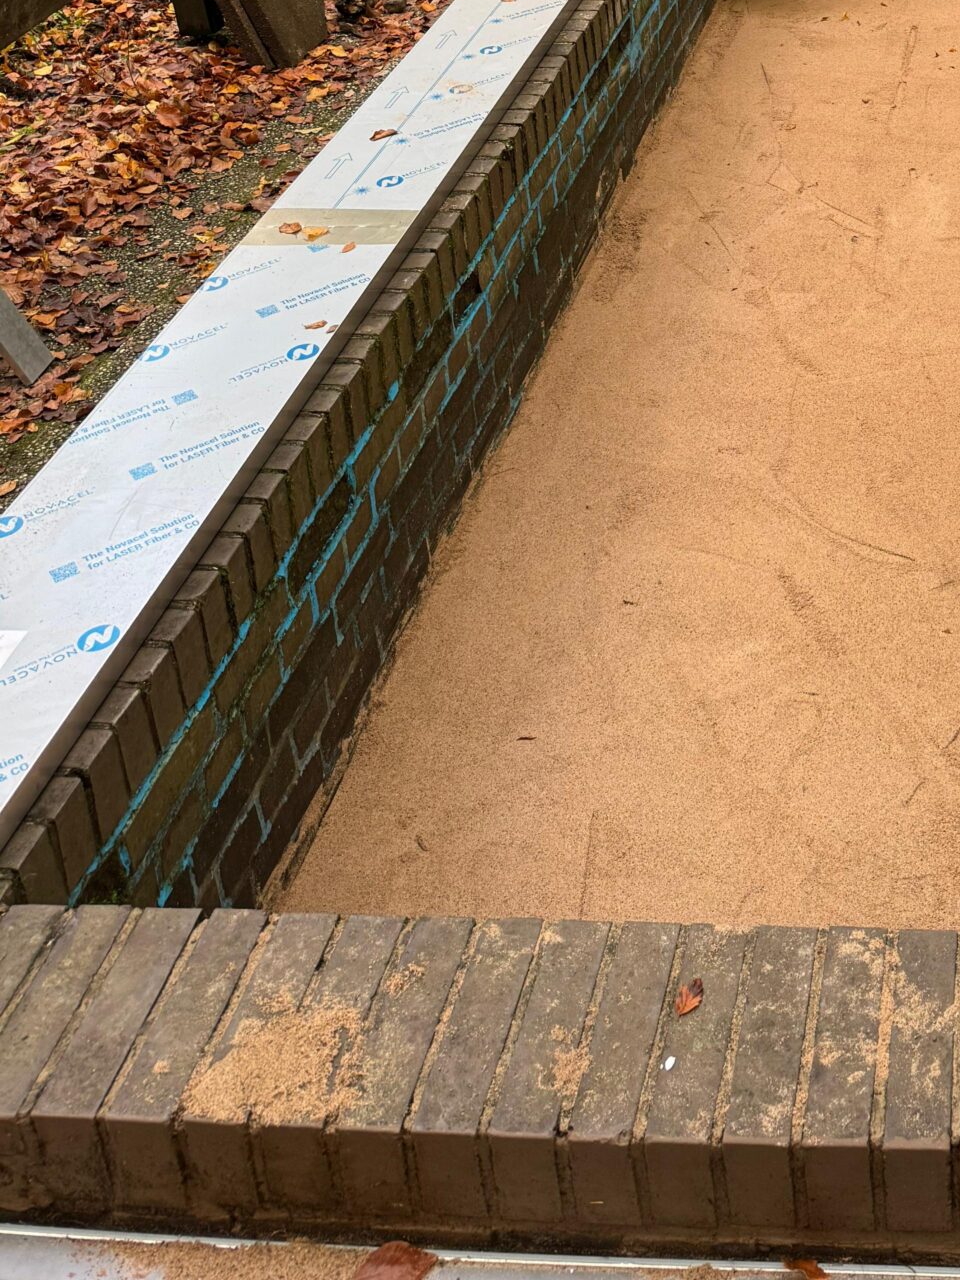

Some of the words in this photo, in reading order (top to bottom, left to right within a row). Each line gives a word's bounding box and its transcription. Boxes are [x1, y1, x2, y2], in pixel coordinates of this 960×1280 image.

[169, 324, 227, 347] NOVACEL
[229, 357, 288, 382] NOVACEL
[160, 454, 178, 463] The
[179, 436, 219, 455] Novacel
[220, 421, 260, 440] Solution
[164, 461, 179, 470] for
[181, 446, 215, 463] LASER
[215, 436, 241, 450] Fiber
[23, 489, 93, 520] NOVACEL
[82, 551, 103, 562] The
[105, 531, 149, 553] Novacel
[150, 513, 194, 535] Solution
[87, 560, 104, 570] for
[106, 543, 144, 563] LASER
[145, 532, 172, 546] Fiber
[185, 520, 200, 530] CO
[0, 648, 78, 686] NOVACEL
